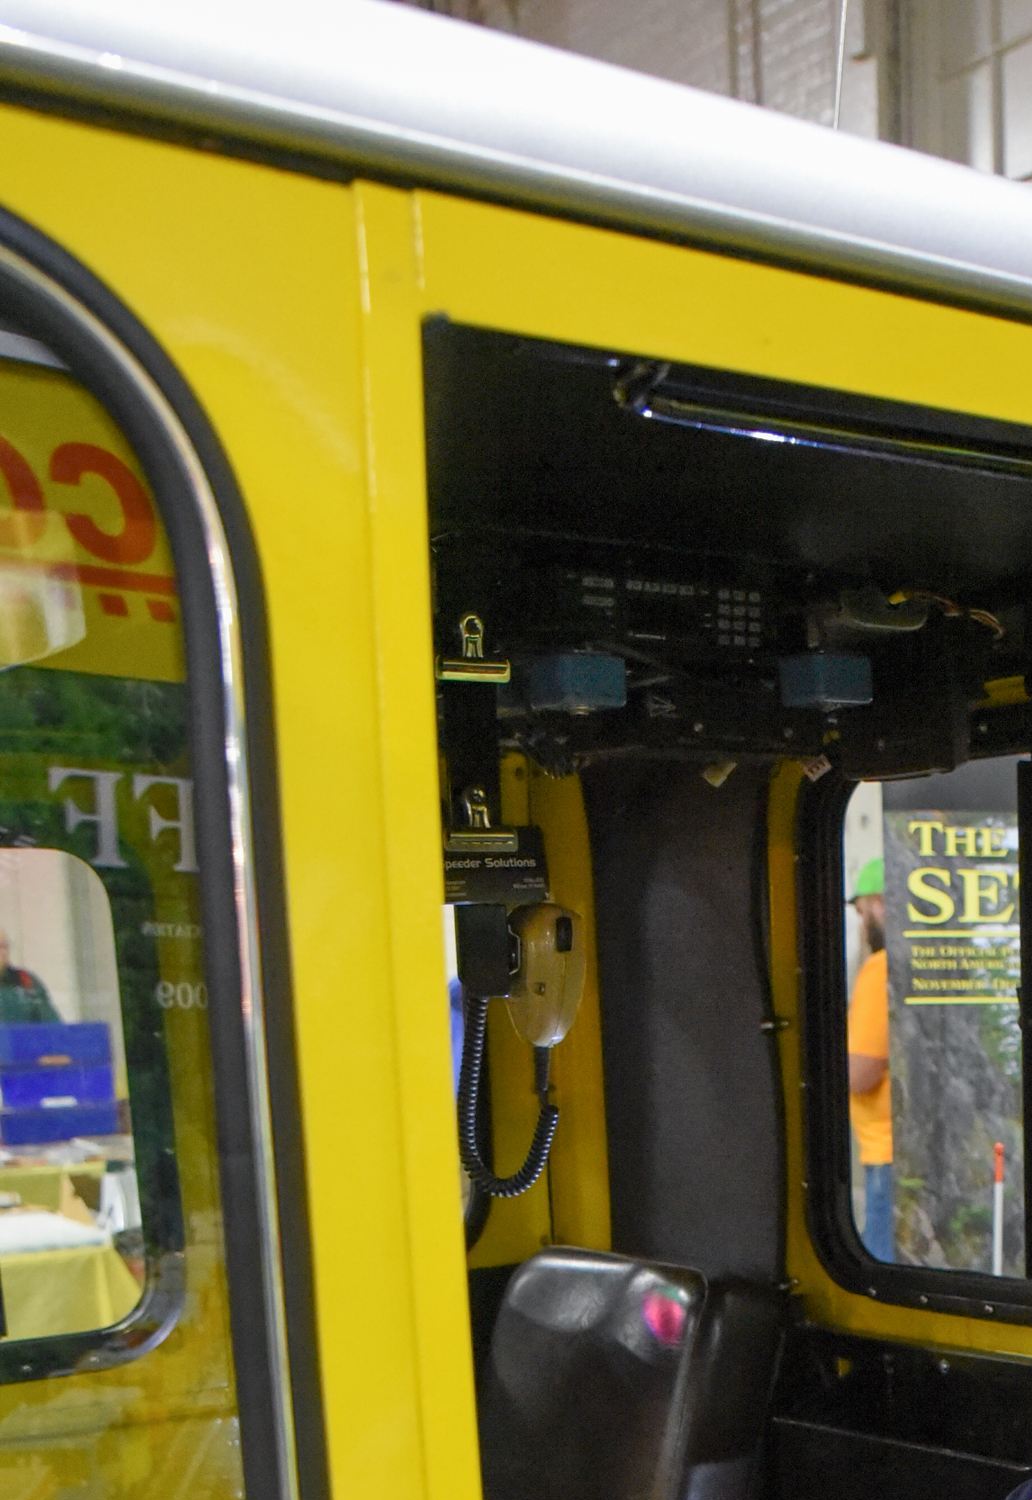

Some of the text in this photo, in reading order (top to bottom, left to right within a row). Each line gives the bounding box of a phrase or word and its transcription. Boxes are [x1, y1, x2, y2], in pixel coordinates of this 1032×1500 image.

[908, 821, 1008, 857] THE
[445, 858, 537, 870] peeder Solutions
